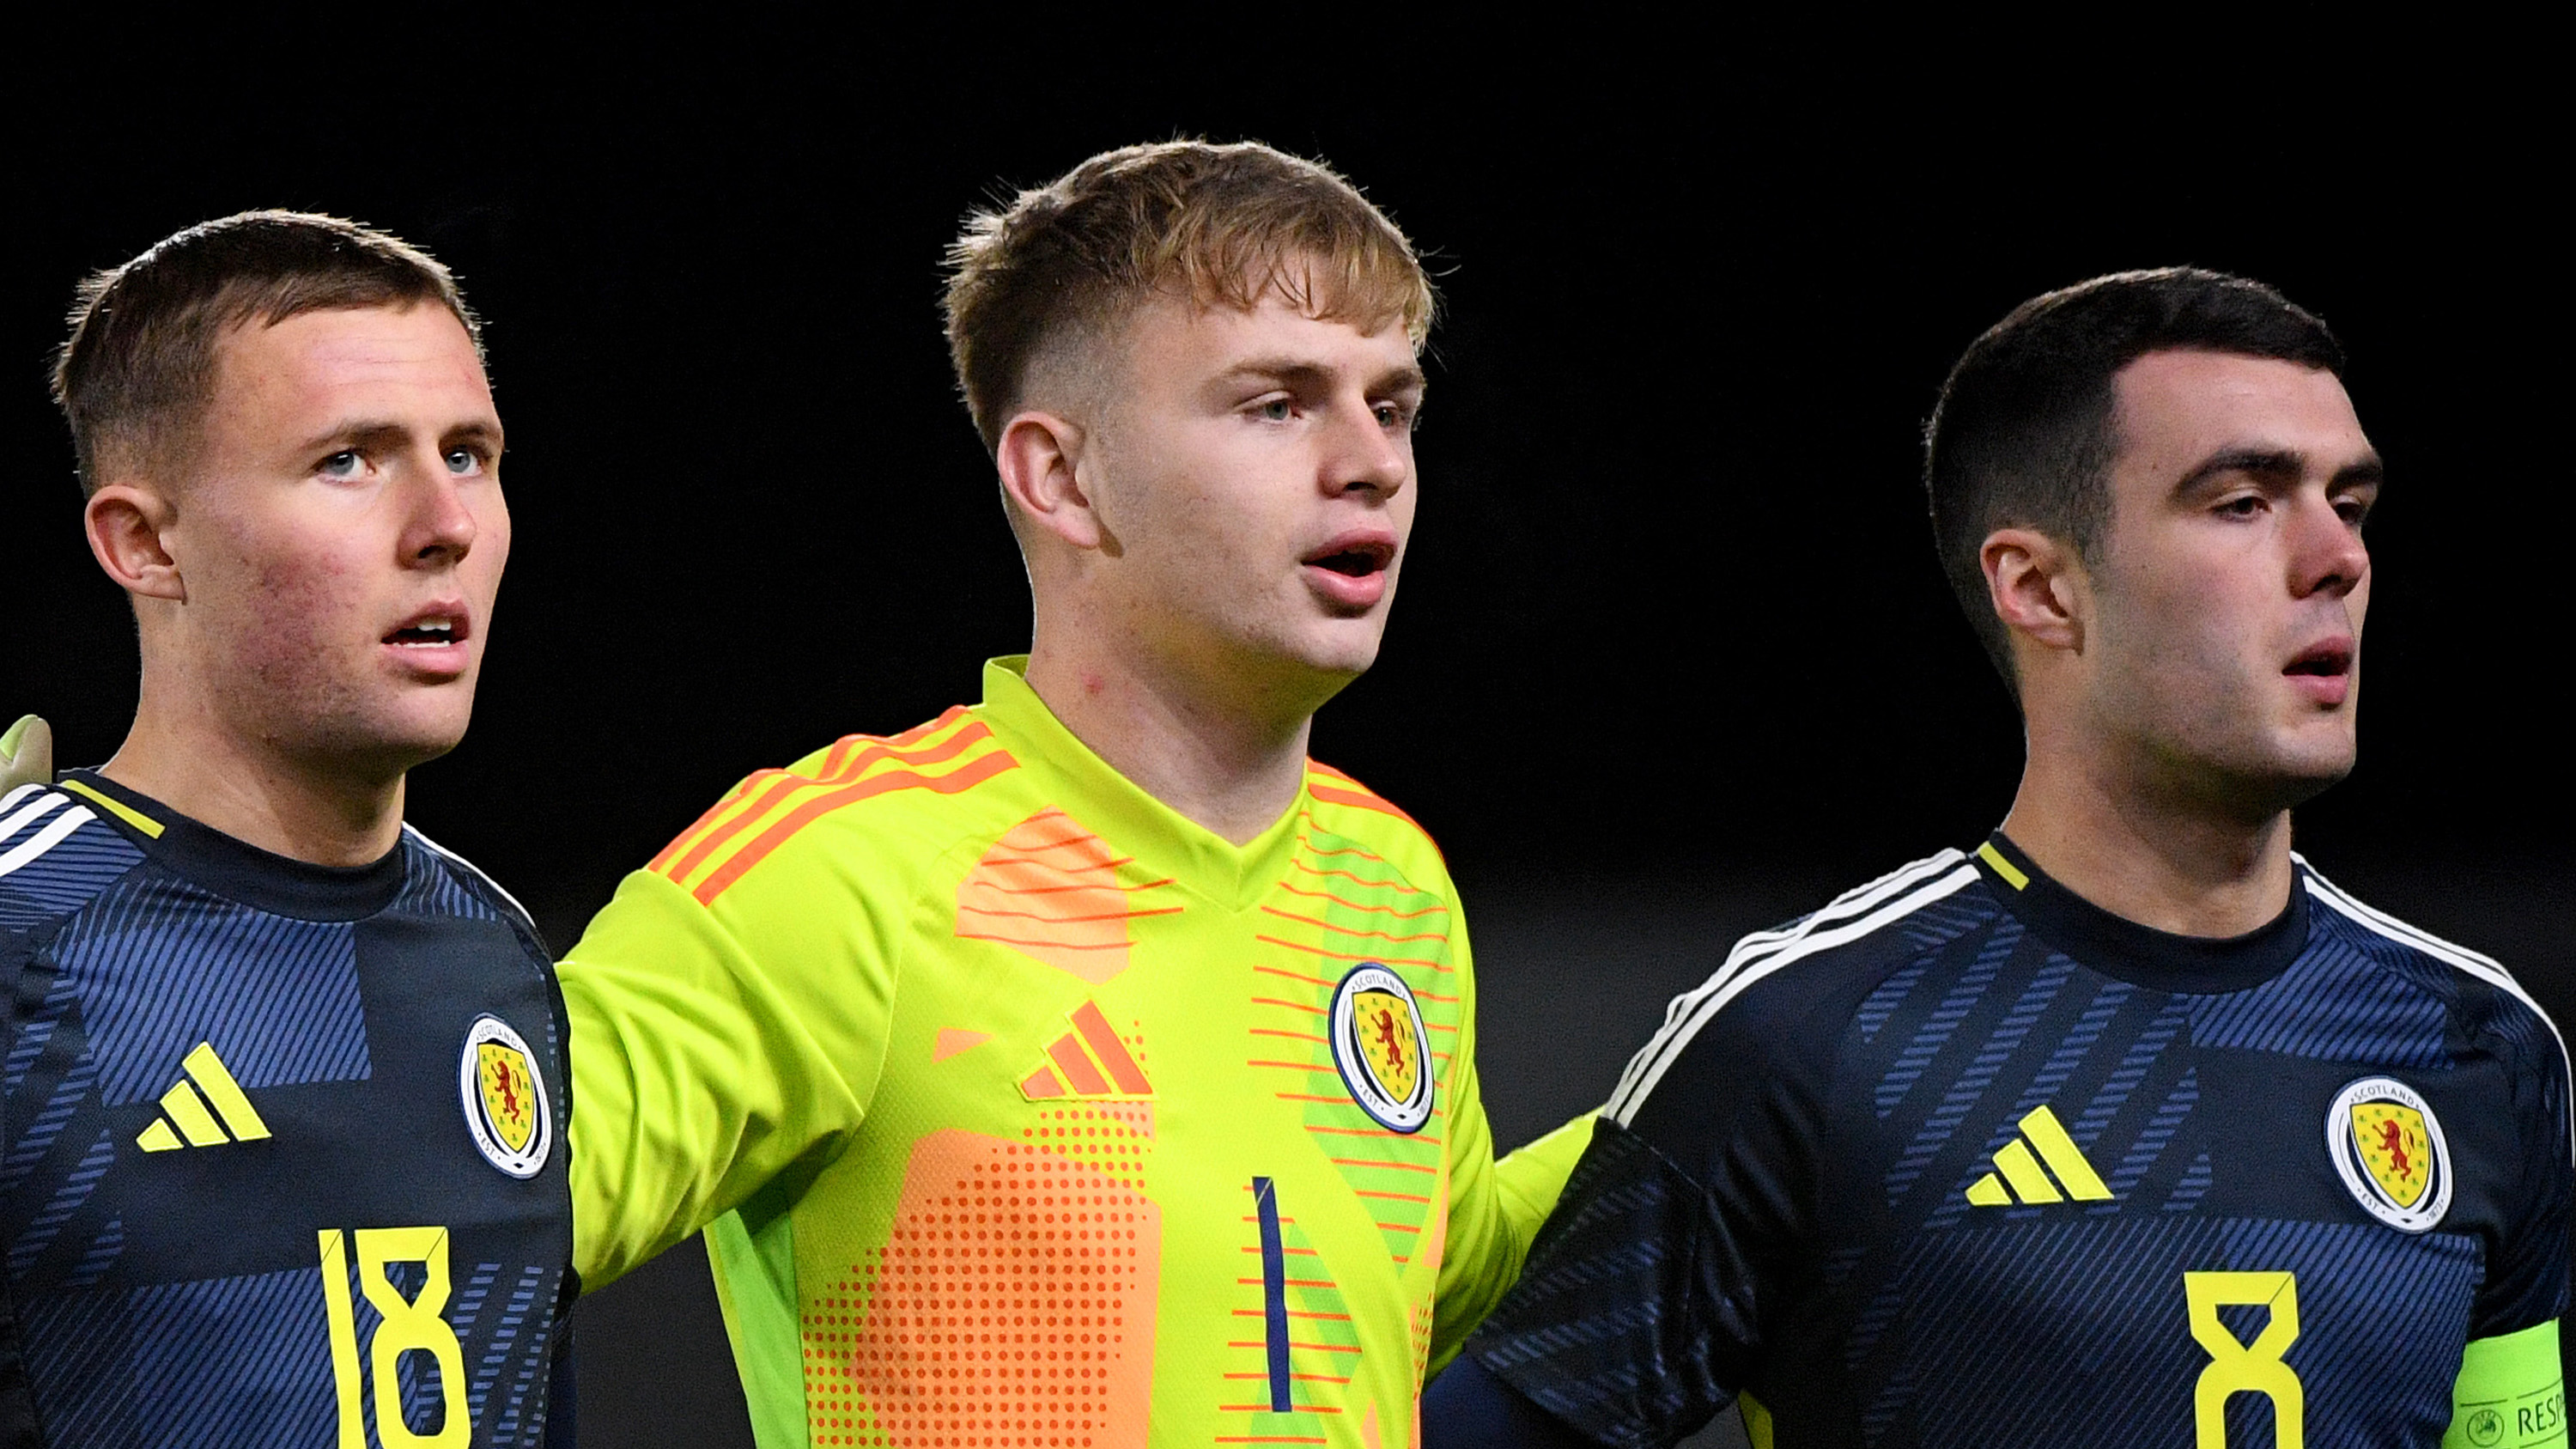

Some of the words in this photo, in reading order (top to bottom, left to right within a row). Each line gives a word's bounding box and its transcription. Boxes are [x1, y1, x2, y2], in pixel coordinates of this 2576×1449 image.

[1354, 974, 1402, 995] SCOTLAND
[1363, 1089, 1378, 1107] EST
[2354, 1085, 2415, 1105] SCOTLAND
[481, 1138, 495, 1157] EST
[2361, 1193, 2379, 1211] EST
[1252, 1176, 1292, 1412] 1
[318, 1226, 472, 1449] 18
[2184, 1271, 2304, 1449] 8
